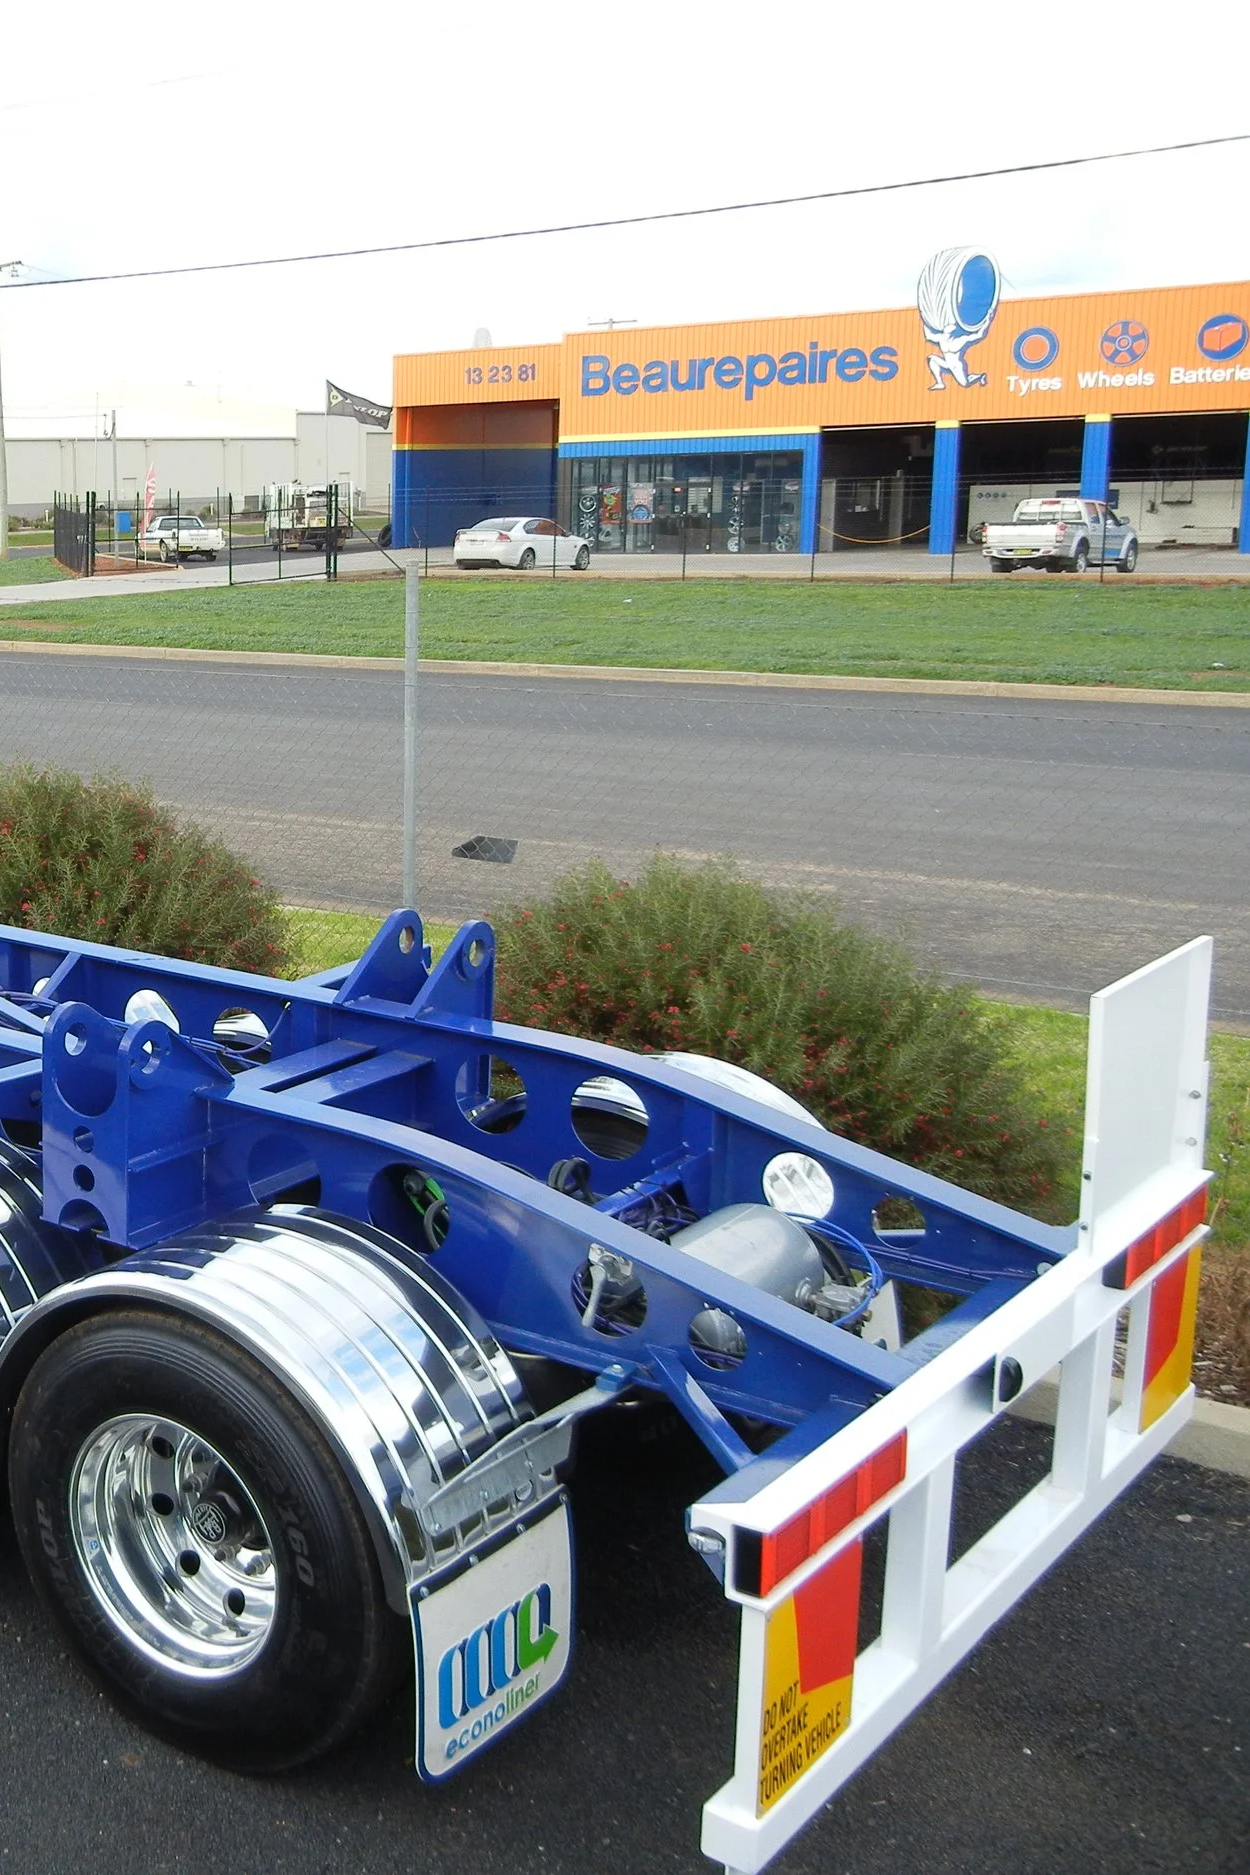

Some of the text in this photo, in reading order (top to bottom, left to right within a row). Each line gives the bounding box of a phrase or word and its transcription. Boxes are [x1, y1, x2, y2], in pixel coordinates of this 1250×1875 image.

[465, 363, 536, 384] 13 23 81
[582, 341, 898, 401] Beaurepaires
[1006, 375, 1063, 396] Tyres
[1077, 368, 1155, 389] Wheels
[444, 1671, 541, 1760] econoliner
[762, 1703, 809, 1770] OVERTAKE
[763, 1680, 799, 1736] DO NOT
[760, 1701, 842, 1805] TURNING VEHICLE
